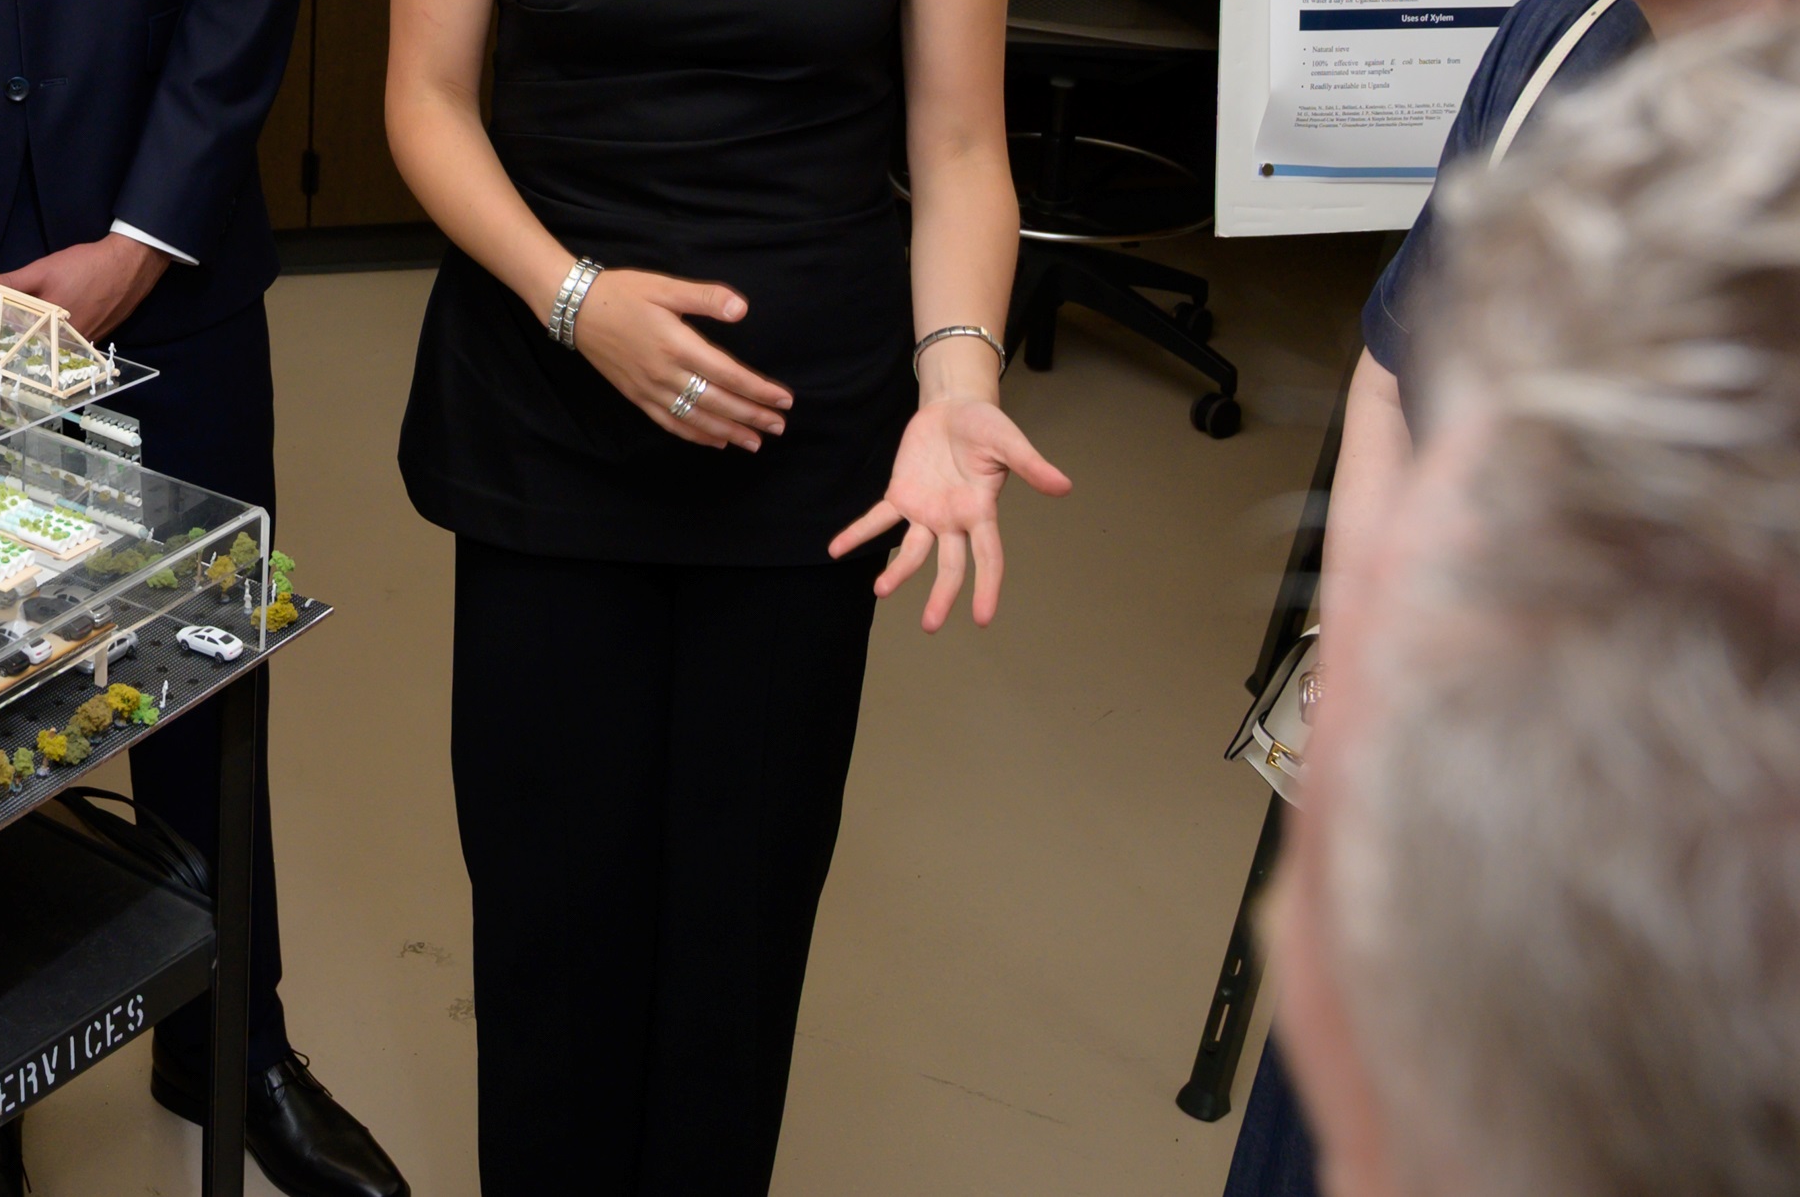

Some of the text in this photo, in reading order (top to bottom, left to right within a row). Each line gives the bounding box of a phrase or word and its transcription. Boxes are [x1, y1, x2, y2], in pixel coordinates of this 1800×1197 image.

[1401, 13, 1454, 24] Uses of Xylem
